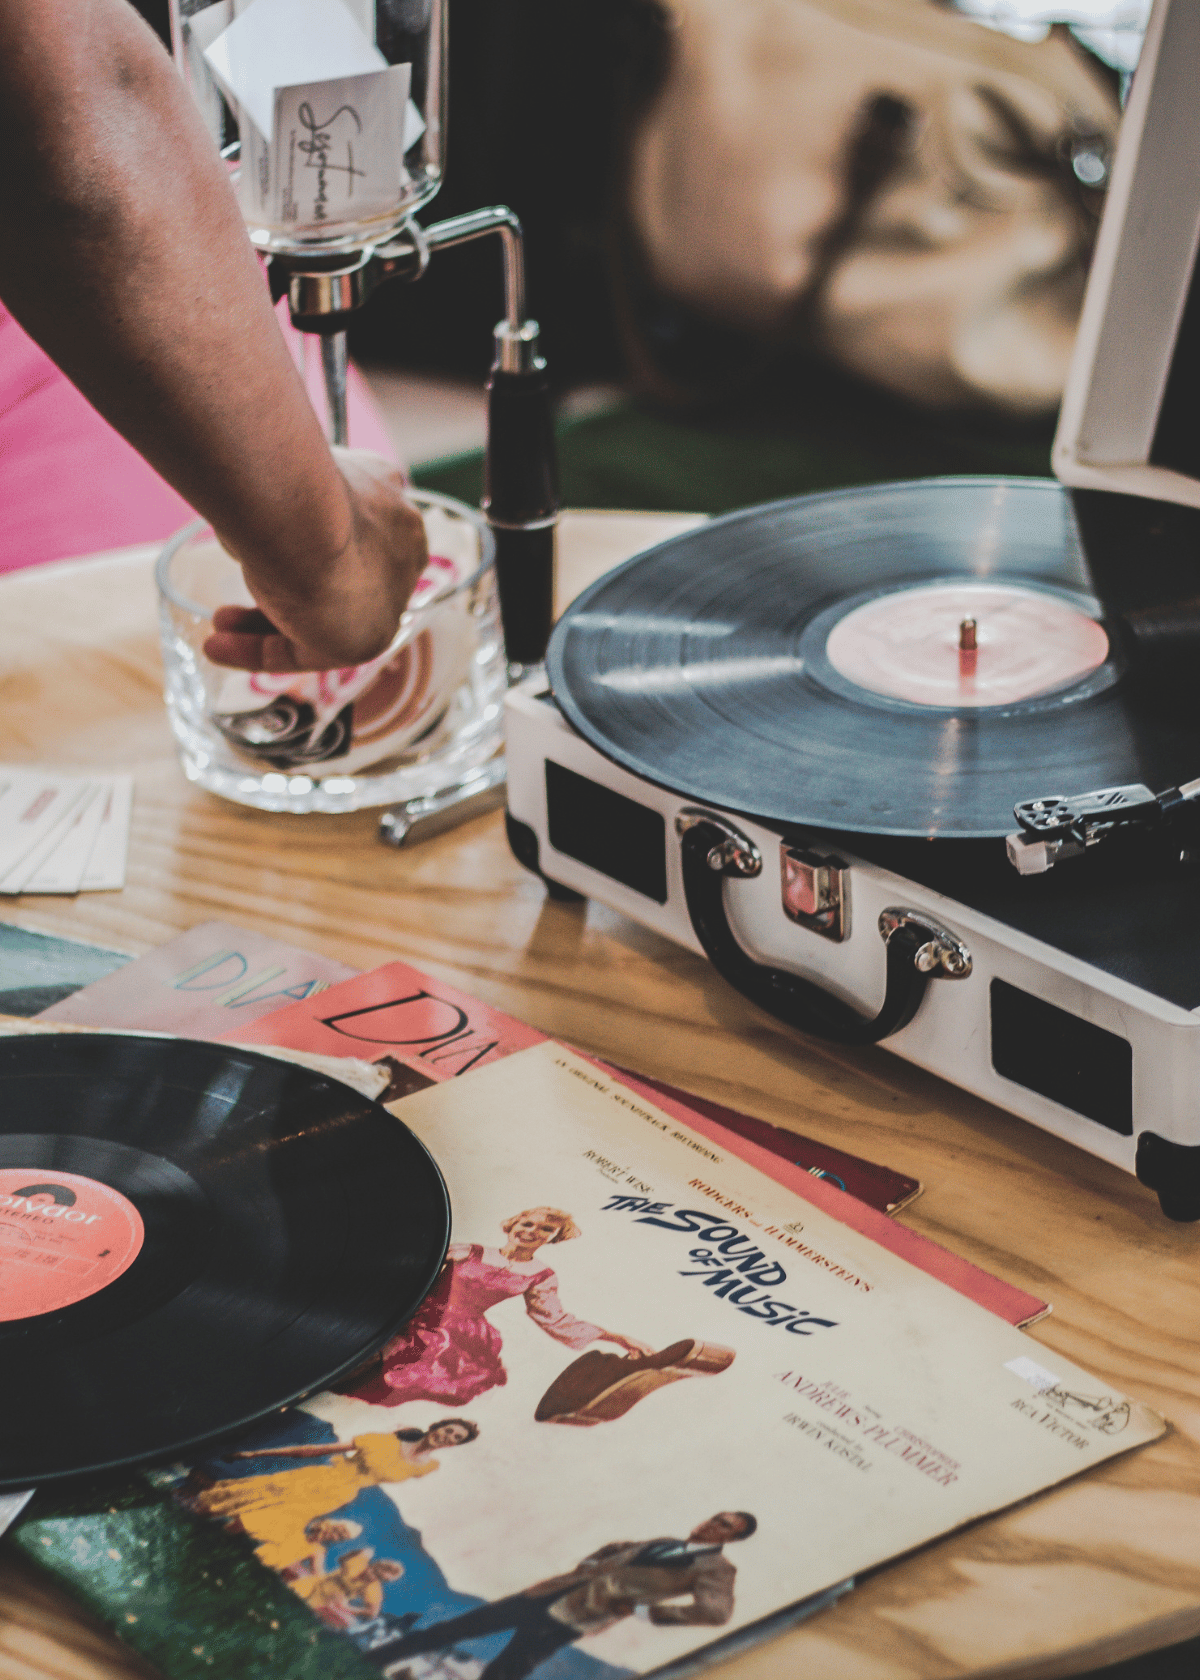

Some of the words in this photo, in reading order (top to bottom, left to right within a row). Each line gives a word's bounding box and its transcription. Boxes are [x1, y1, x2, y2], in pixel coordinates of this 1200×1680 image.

[313, 989, 500, 1076] DIA
[582, 1149, 627, 1176] ROBERT
[599, 1194, 675, 1215] THE
[688, 1178, 753, 1219] RODGERS
[631, 1209, 787, 1287] SOUND
[688, 1248, 725, 1267] OF
[772, 1370, 862, 1427] ANDREWS
[862, 1424, 960, 1487] PLUMMER
